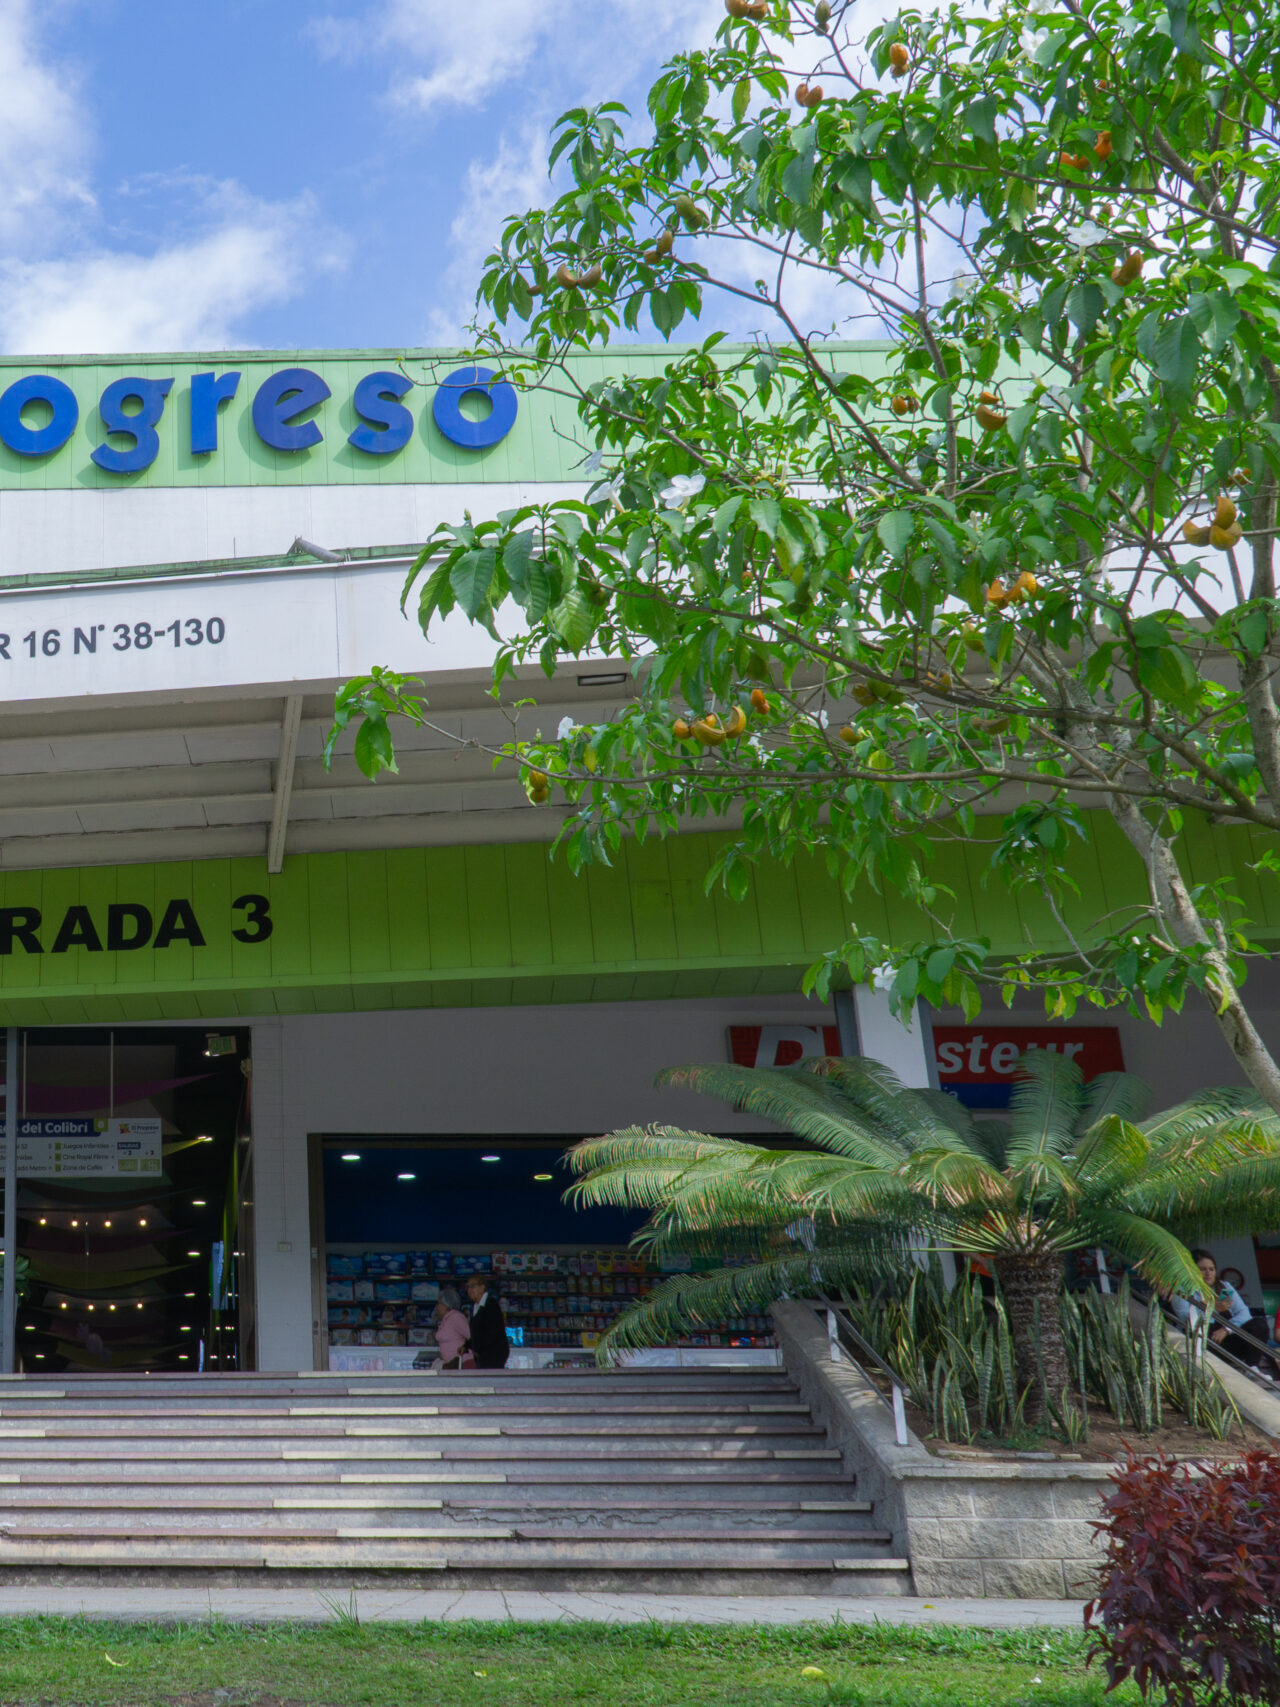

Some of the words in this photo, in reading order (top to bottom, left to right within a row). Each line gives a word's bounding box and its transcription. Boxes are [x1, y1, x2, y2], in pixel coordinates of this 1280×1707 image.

[23, 629, 61, 659] 16
[112, 617, 226, 652] 38-130
[231, 894, 275, 944] 3
[21, 1121, 42, 1134] del
